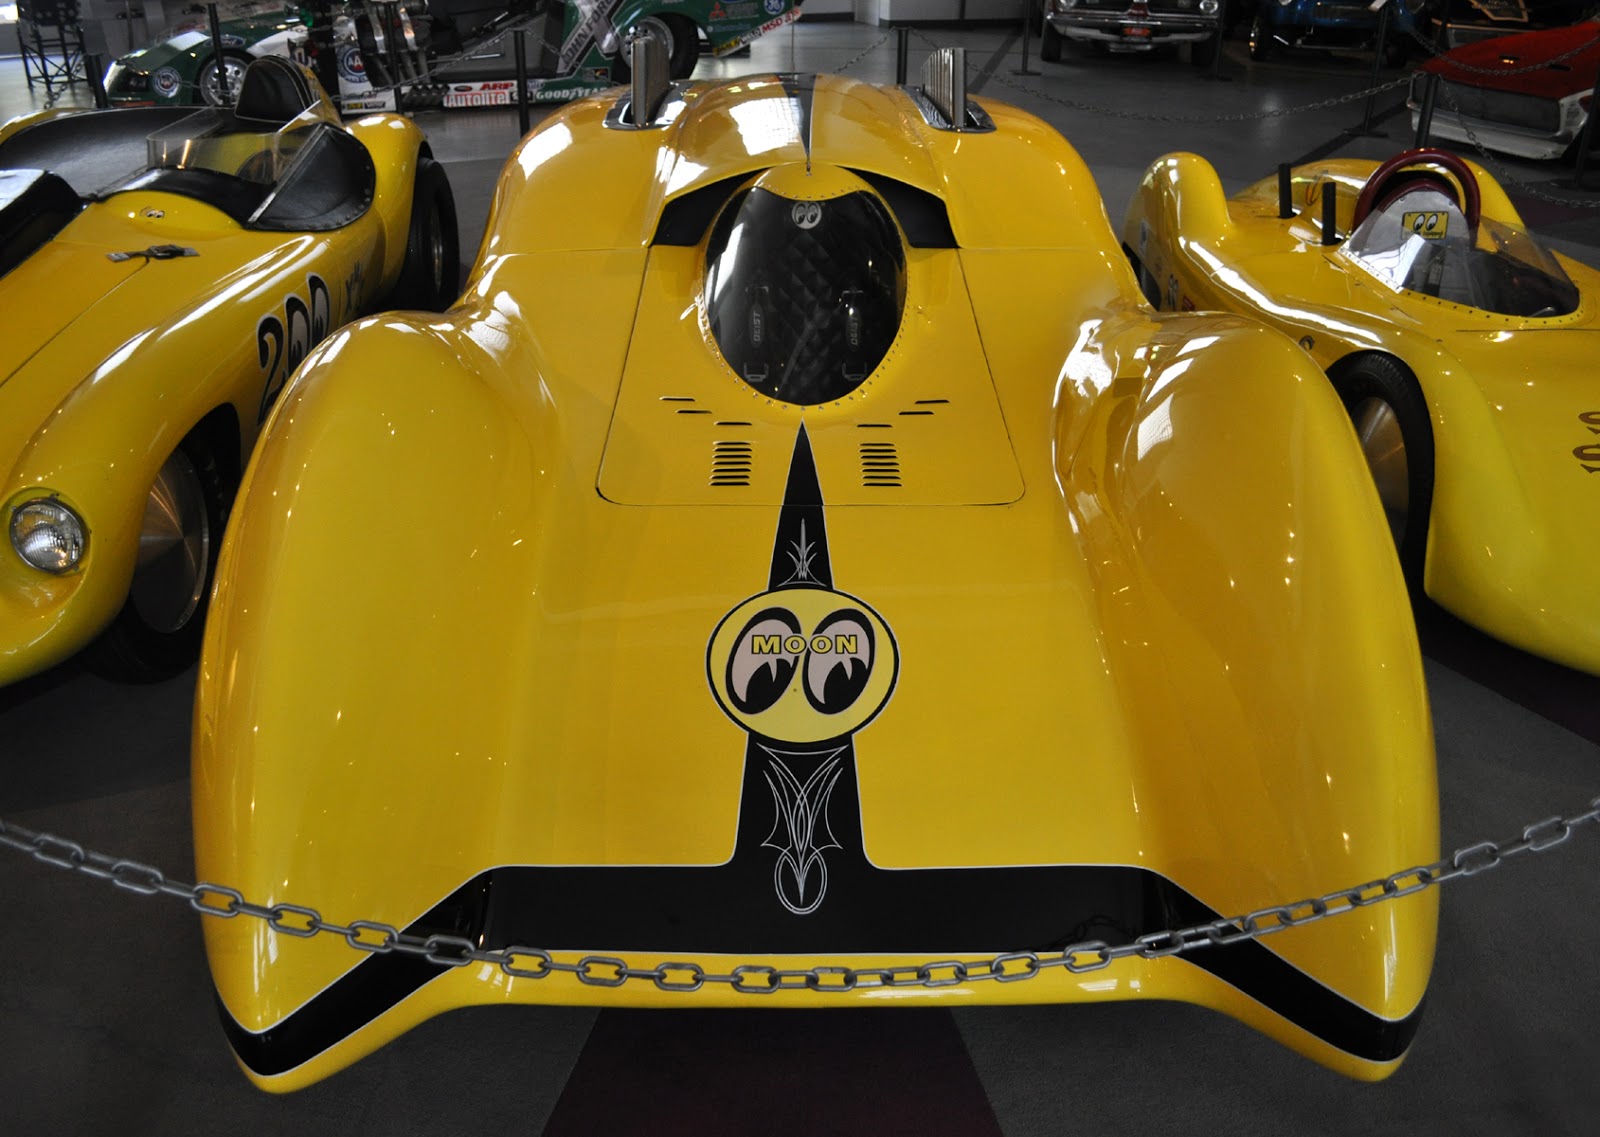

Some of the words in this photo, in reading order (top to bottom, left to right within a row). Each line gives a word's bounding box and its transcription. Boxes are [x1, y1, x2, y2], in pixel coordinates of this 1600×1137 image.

[762, 17, 783, 34] MSD
[561, 27, 590, 70] JOHN
[479, 82, 514, 91] ARP
[753, 311, 761, 342] DEIST
[751, 634, 858, 655] MOON
